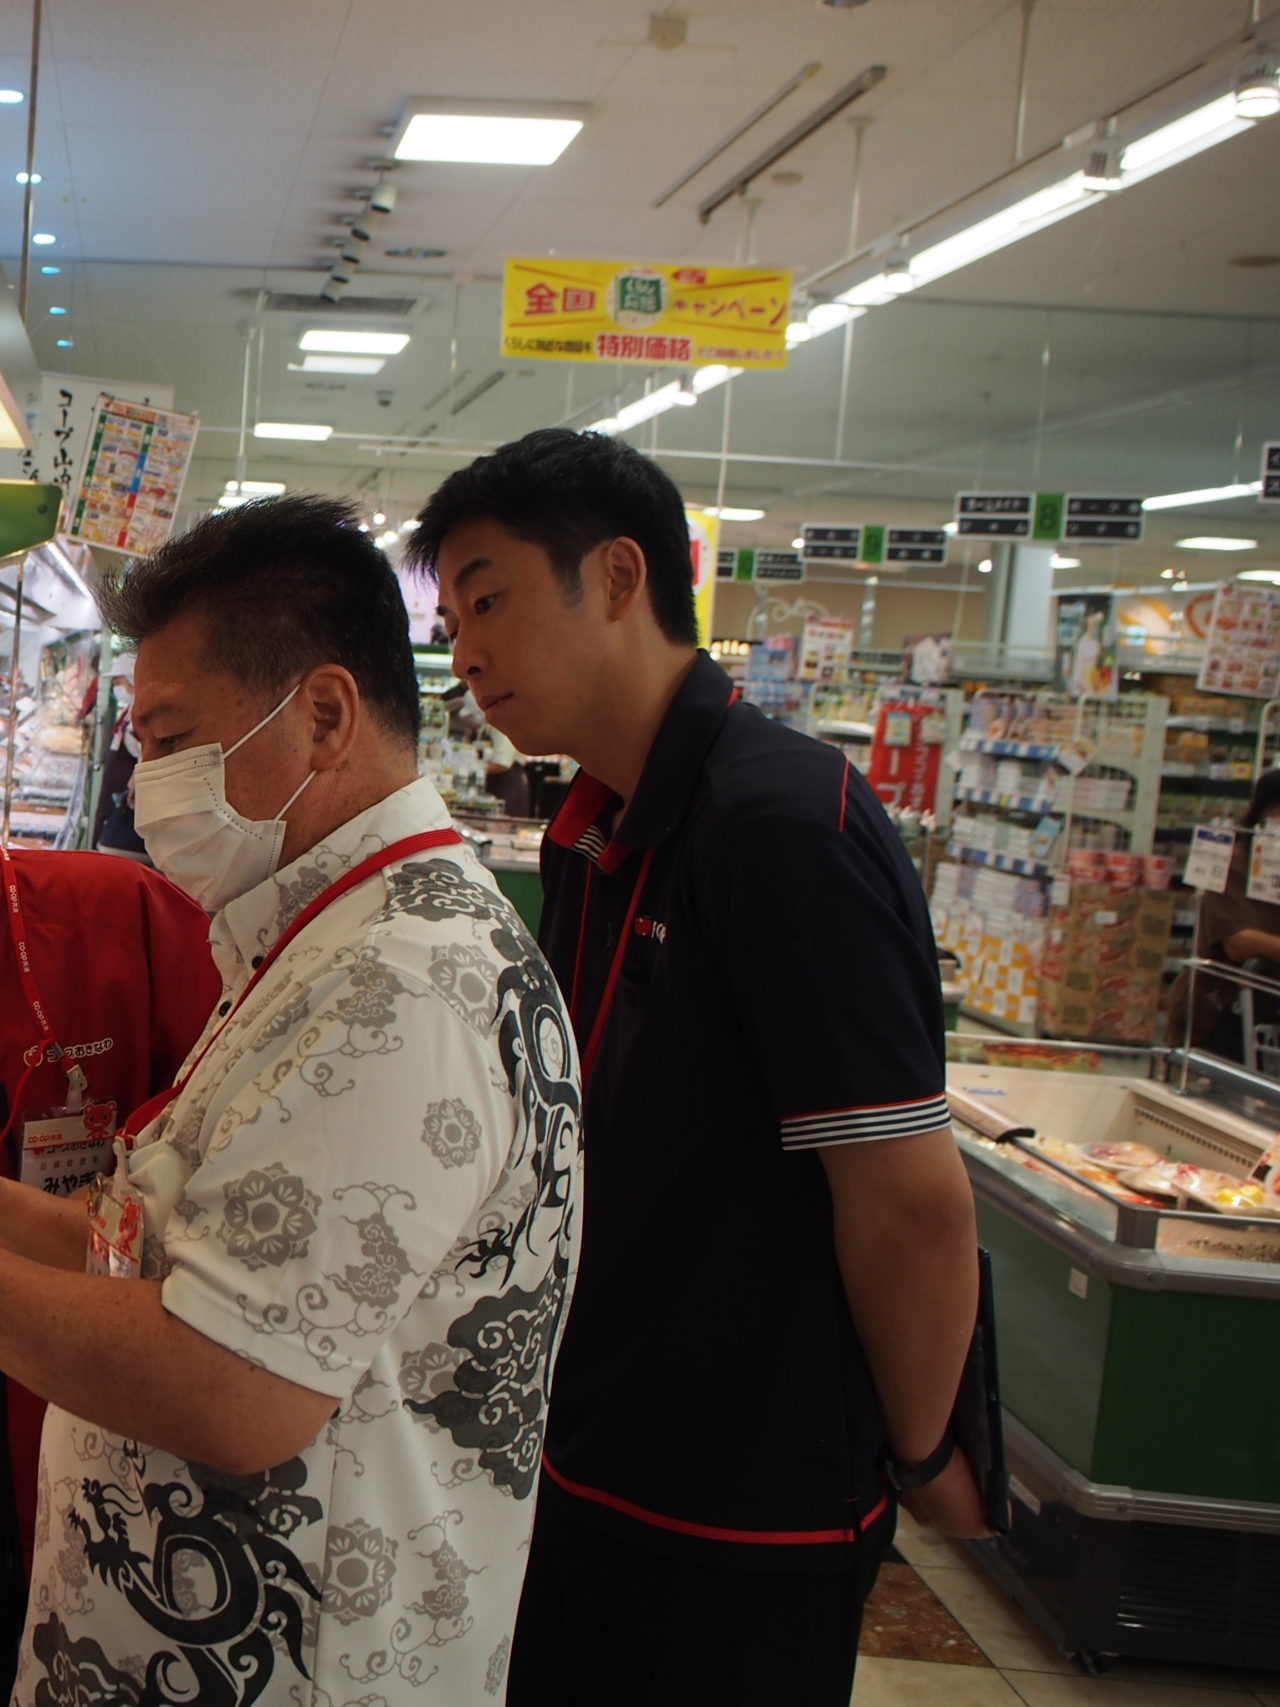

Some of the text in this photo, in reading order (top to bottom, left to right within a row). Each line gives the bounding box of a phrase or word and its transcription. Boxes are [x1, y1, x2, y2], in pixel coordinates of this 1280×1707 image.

[524, 282, 596, 316] 全国
[673, 297, 787, 327] キャンペーン
[597, 334, 691, 361] 特別価格
[1039, 502, 1058, 532] 8
